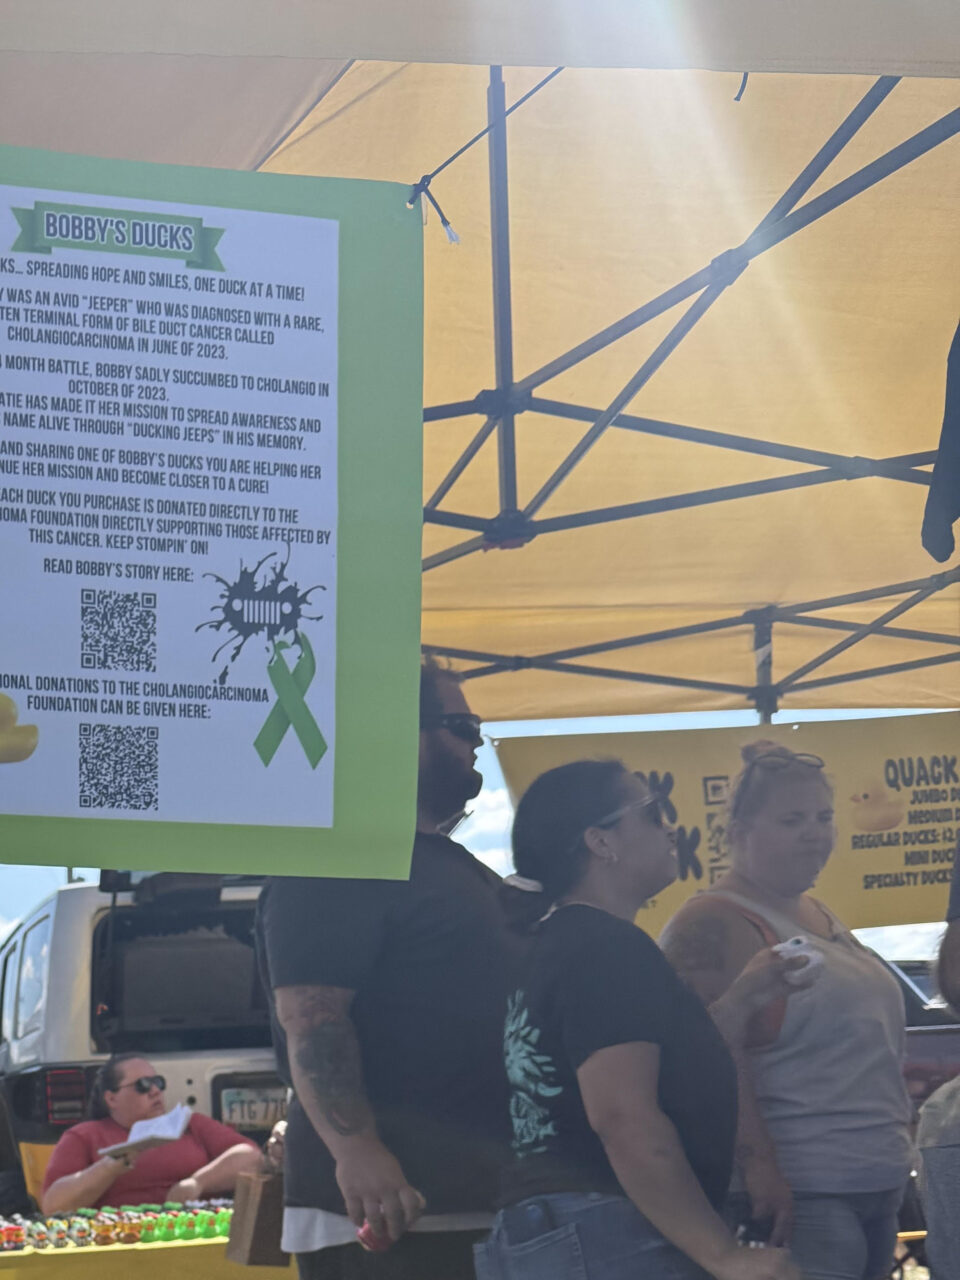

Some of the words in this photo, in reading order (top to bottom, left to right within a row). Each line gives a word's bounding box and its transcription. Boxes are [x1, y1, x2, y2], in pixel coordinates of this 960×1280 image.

[45, 213, 126, 243] BOBBY'S
[132, 221, 193, 251] DUCKS
[26, 260, 89, 280] SPREADING
[91, 266, 120, 283] HOPE
[122, 269, 146, 286] AND
[148, 272, 191, 290] SMILES,
[193, 276, 215, 292] ONE
[218, 278, 247, 295] DUCK
[249, 281, 262, 296] AT
[265, 283, 273, 297] A
[276, 284, 305, 300] TIME!
[6, 287, 32, 304] WAS
[34, 290, 50, 305] AN
[52, 292, 79, 308] AVID
[135, 299, 162, 316] WHO
[163, 302, 189, 318] WAS
[190, 304, 251, 324] DIAGNOSED
[253, 310, 281, 326] WITH
[283, 313, 291, 327] A
[293, 314, 324, 331] RARE,
[24, 308, 79, 327] TERMINAL
[82, 313, 113, 330] FORM
[115, 316, 128, 331] OF
[132, 318, 155, 333] BILE
[158, 320, 186, 336] DUCT
[188, 322, 232, 340] CANCER
[234, 326, 275, 343] CALLED
[6, 327, 135, 351] CHOLANGIOCARCINOMA
[137, 337, 149, 352] IN
[152, 339, 177, 354] JUNE
[180, 341, 193, 355] OF
[196, 342, 228, 359] 2023.
[4, 355, 45, 373] MONTH
[47, 359, 92, 377] BATTLE,
[95, 363, 131, 380] BOBBY
[134, 366, 169, 383] SADLY
[172, 369, 238, 389] SUCCUMBED
[241, 375, 255, 390] TO
[256, 376, 316, 395] CHOLANGIO
[318, 382, 329, 396] IN
[24, 394, 48, 410] HAS
[50, 396, 82, 413] MADE
[84, 399, 94, 414] IT
[98, 400, 120, 416] HER
[122, 402, 168, 420] MISSION
[171, 406, 185, 421] TO
[186, 408, 229, 425] SPREAD
[231, 411, 297, 430] AWARENESS
[298, 417, 321, 432] AND
[26, 489, 56, 506] DUCK
[59, 492, 81, 507] YOU
[83, 493, 140, 511] PURCHASE
[143, 498, 154, 512] IS
[156, 499, 207, 516] DONATED
[208, 502, 259, 520] DIRECTLY
[262, 506, 276, 521] TO
[278, 507, 298, 522] THE
[29, 529, 53, 544] THIS
[55, 530, 102, 548] CANCER.
[105, 533, 134, 549] KEEP
[136, 535, 187, 553] STOMPIN'
[190, 539, 208, 554] ON!
[30, 508, 99, 527] FOUNDATION
[101, 513, 153, 531] DIRECTLY
[156, 517, 223, 536] SUPPORTING
[226, 522, 258, 538] THOSE
[261, 525, 314, 542] AFFECTED
[316, 529, 330, 543] BY
[43, 558, 73, 574] READ
[75, 560, 123, 577] BOBBY'S
[124, 563, 159, 579] STORY
[162, 566, 193, 581] HERE:
[35, 675, 99, 693] DONATIONS
[102, 679, 116, 694] TO
[119, 680, 140, 695] THE
[142, 681, 268, 701] CHOLANGIOCARCINOMA
[26, 695, 98, 713] FOUNDATION
[100, 699, 123, 714] CAN
[126, 700, 140, 715] BE
[142, 701, 176, 717] GIVEN
[178, 703, 211, 718] HERE:
[851, 832, 900, 849] REGULAR
